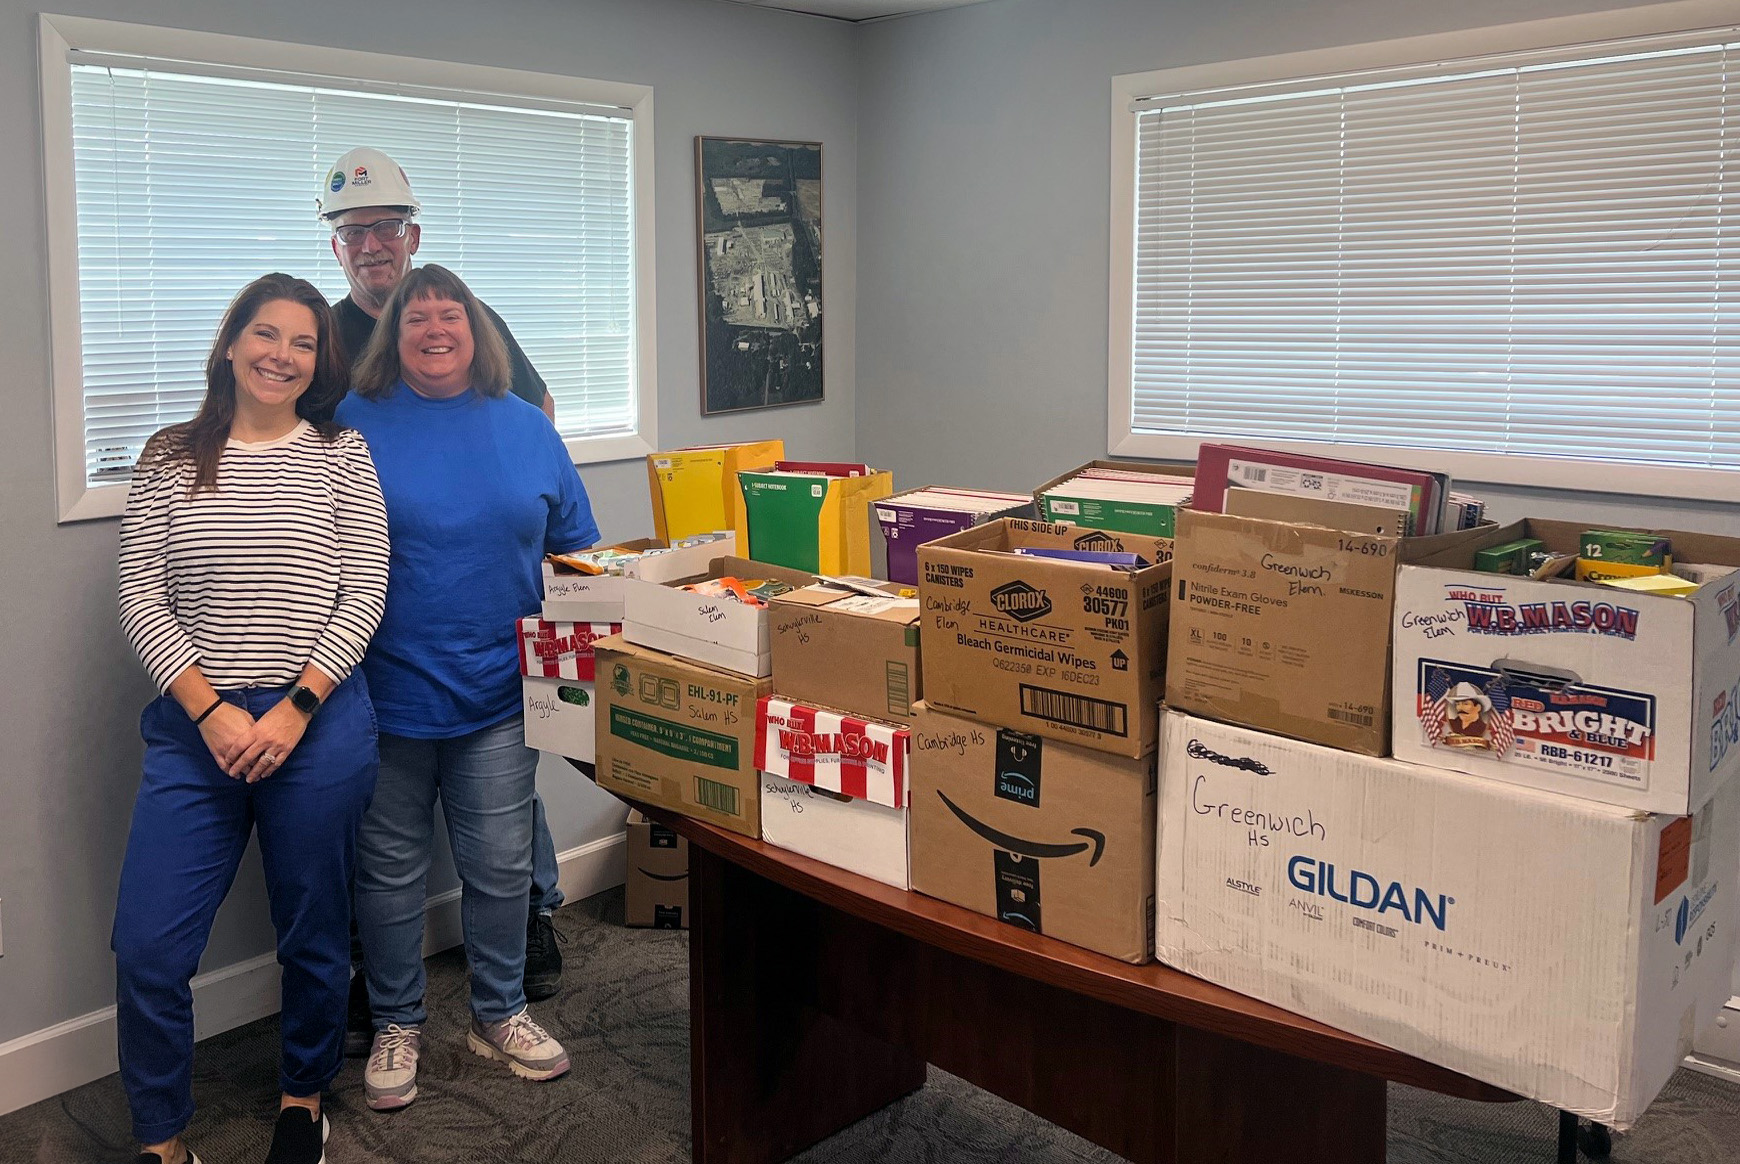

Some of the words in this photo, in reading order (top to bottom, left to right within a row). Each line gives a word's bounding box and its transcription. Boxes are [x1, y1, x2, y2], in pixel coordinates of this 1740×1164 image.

[1010, 519, 1029, 532] THIS
[1031, 522, 1052, 534] SIDE
[1055, 524, 1068, 536] UP
[1338, 539, 1387, 557] 14-690
[1586, 543, 1603, 557] 12
[925, 562, 930, 572] 6
[937, 564, 949, 575] 150
[950, 565, 974, 579] WIPES
[1242, 569, 1257, 579] 3.8
[1260, 553, 1332, 582] Greenwich
[926, 573, 964, 588] CANISTERS
[996, 590, 1048, 613] CLOROX
[1096, 586, 1128, 600] 44600
[1191, 582, 1219, 596] Nitrile
[1221, 587, 1248, 601] Exam
[1250, 592, 1288, 608] Gloves
[1449, 591, 1477, 601] WHO
[1479, 593, 1504, 603] BUT
[1084, 596, 1129, 618] 30577
[1190, 594, 1262, 616] POWDER-FREE
[1105, 618, 1130, 631] PK01
[1401, 608, 1466, 629] Greenwich
[798, 634, 810, 646] HS
[1190, 628, 1203, 639] XL
[1213, 632, 1227, 641] 100
[1242, 638, 1252, 646] 10
[957, 633, 992, 651] Bleach
[994, 640, 1055, 663] Germicidal
[1058, 652, 1097, 671] Wipes
[1113, 657, 1126, 668] UP
[1036, 665, 1056, 678] EXP
[1061, 670, 1101, 686] 16DEC23
[688, 684, 739, 707] EHL-91-PF
[528, 694, 560, 719] Argyle
[689, 705, 718, 722] Salem
[724, 712, 739, 726] HS
[1344, 702, 1374, 715] 14-690
[767, 716, 785, 727] WHO
[787, 720, 804, 731] BUT
[1512, 709, 1652, 746] BRIGHT
[917, 733, 968, 756] Cambridge
[971, 729, 985, 746] HS
[1568, 730, 1580, 740] &
[1587, 732, 1628, 748] BLUE
[1541, 744, 1613, 768] RBB-61217
[1619, 772, 1642, 781] Sheets
[1000, 783, 1034, 800] prime
[791, 800, 804, 813] HS
[1193, 775, 1326, 841] Greenwich
[1226, 878, 1261, 894] ALSTYLE
[1289, 898, 1323, 917] ANVIL
[1353, 917, 1376, 932] COMFORT
[1376, 924, 1398, 938] COLORS
